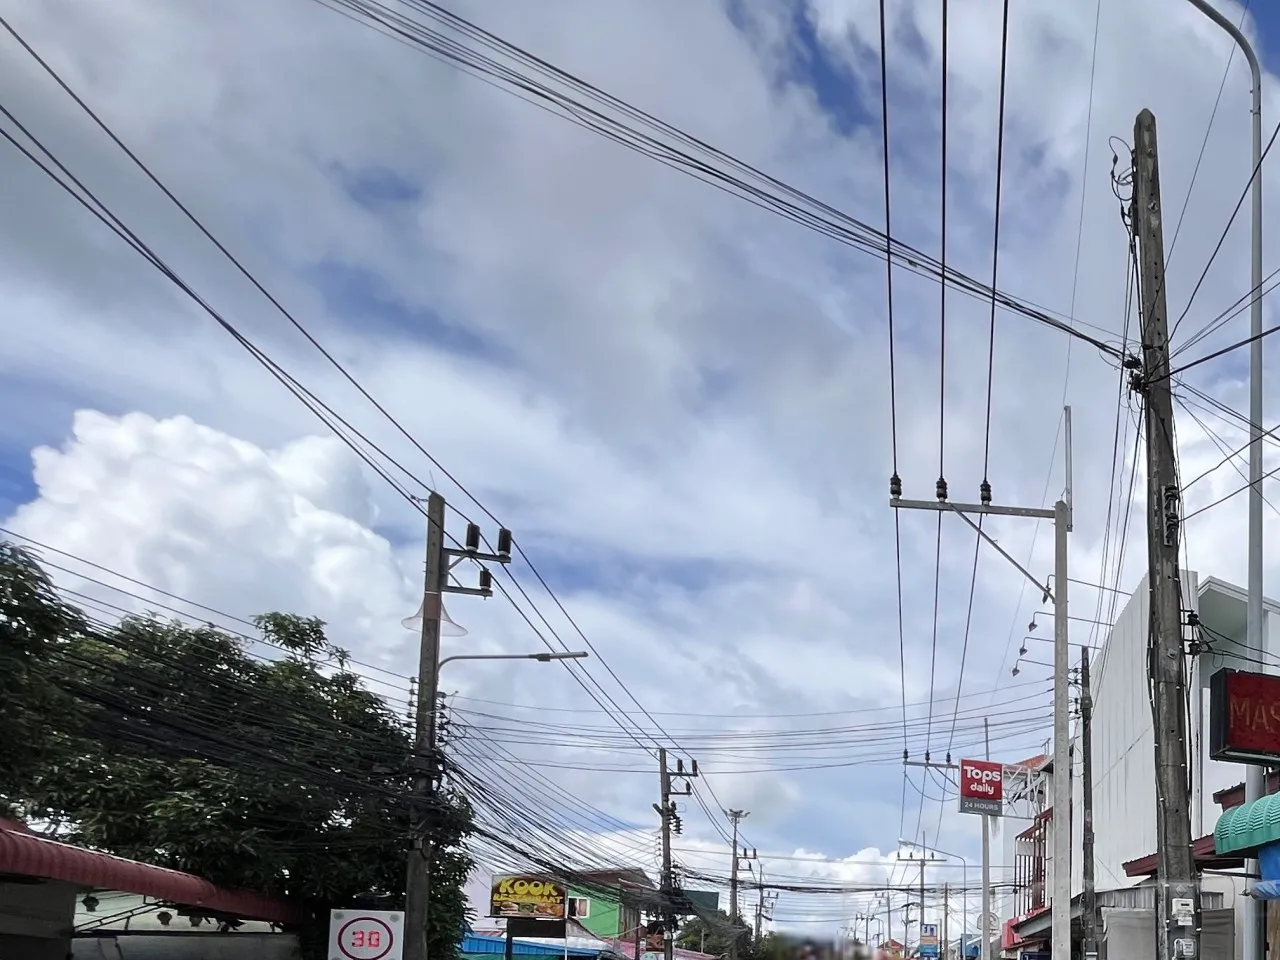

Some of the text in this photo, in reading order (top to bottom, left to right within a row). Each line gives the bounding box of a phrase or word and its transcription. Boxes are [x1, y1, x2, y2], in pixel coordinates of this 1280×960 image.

[963, 765, 1001, 783] Tops
[970, 782, 994, 795] daily
[499, 878, 558, 896] KOOK
[352, 930, 380, 948] 30
